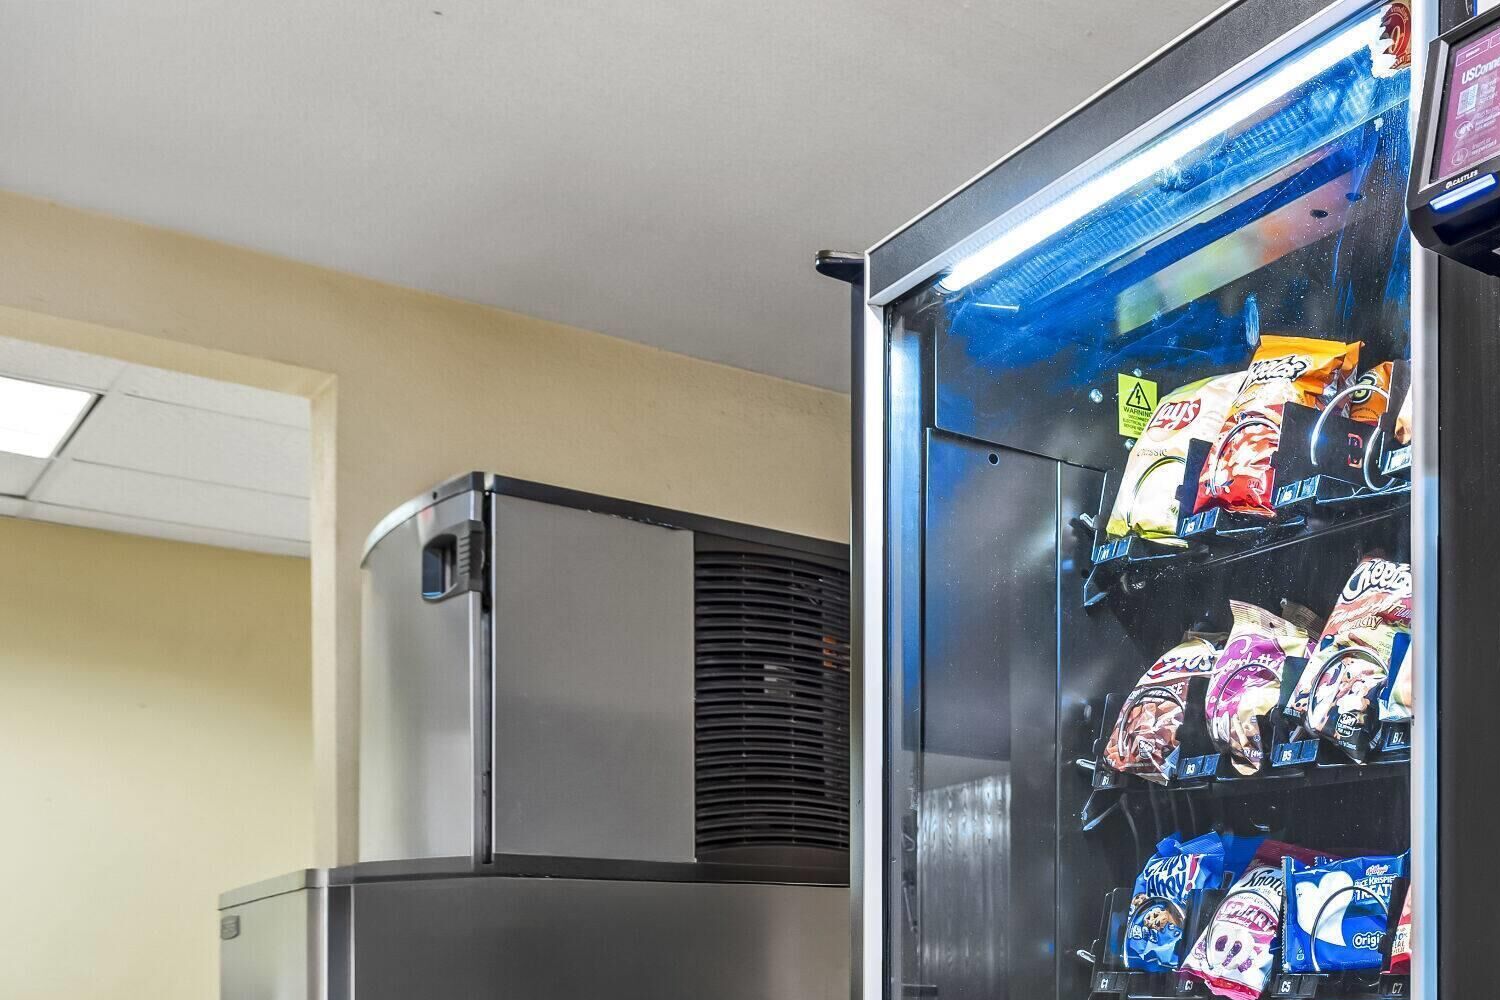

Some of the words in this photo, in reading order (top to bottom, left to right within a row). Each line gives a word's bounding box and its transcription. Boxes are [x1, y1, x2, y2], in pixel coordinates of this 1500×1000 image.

[1369, 873, 1398, 886] KRISPIE
[1355, 883, 1392, 901] TREAT
[1353, 932, 1386, 949] Origi
